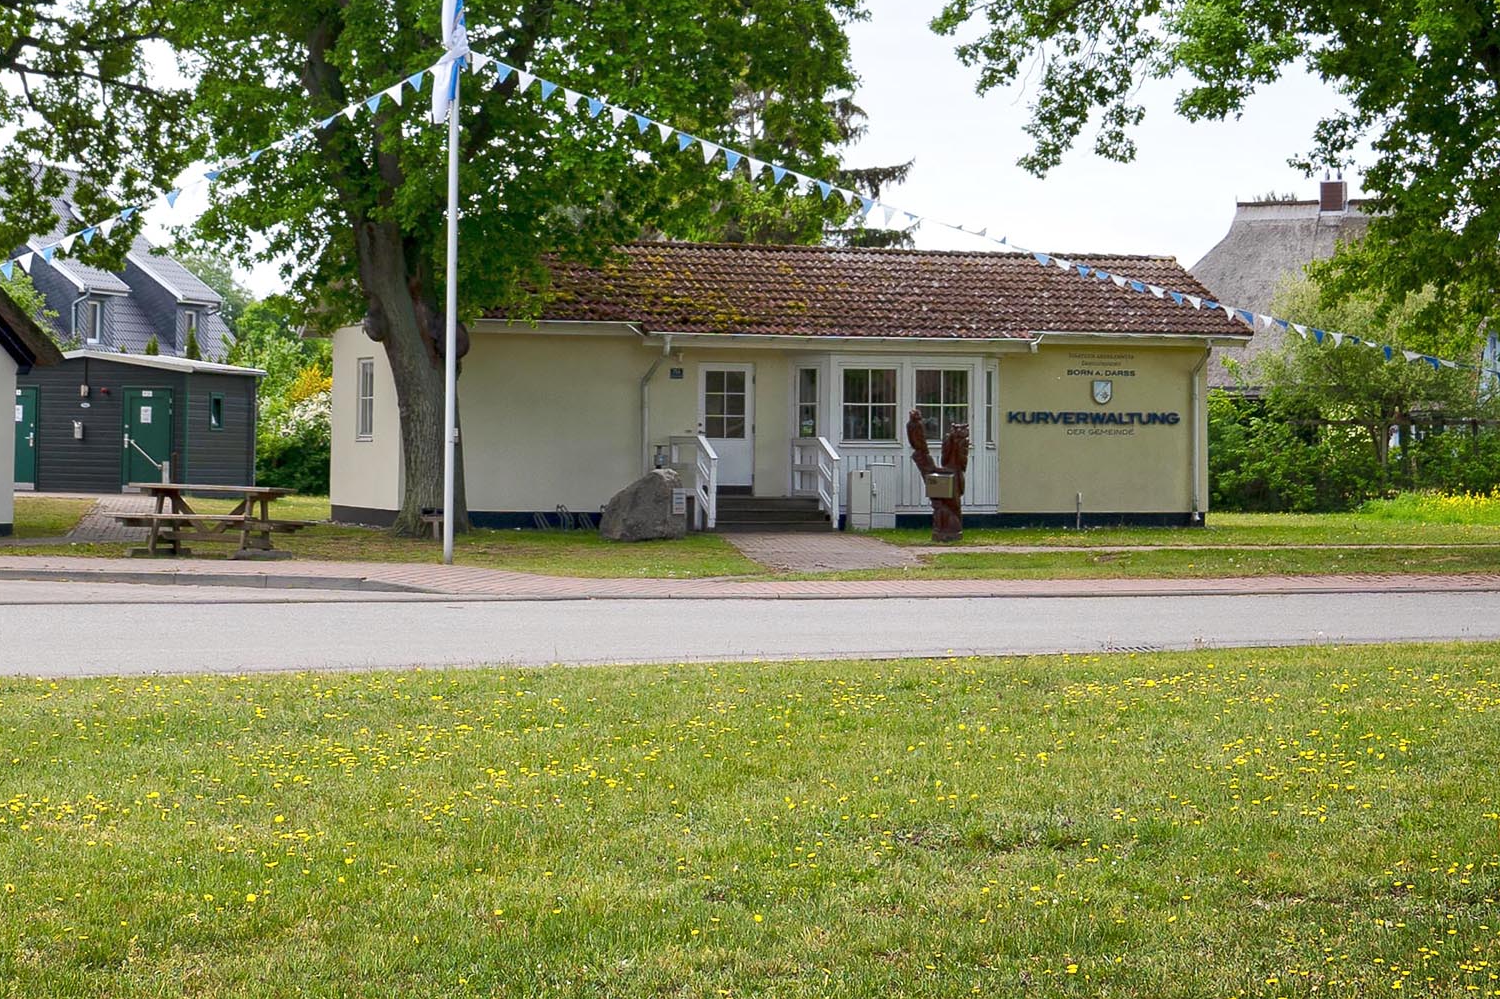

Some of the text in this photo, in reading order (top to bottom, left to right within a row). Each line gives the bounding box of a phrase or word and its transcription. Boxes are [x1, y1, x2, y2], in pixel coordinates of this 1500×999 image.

[1007, 411, 1181, 426] KURVERWALTUNG
[1067, 428, 1135, 436] DER GEMEINDE
